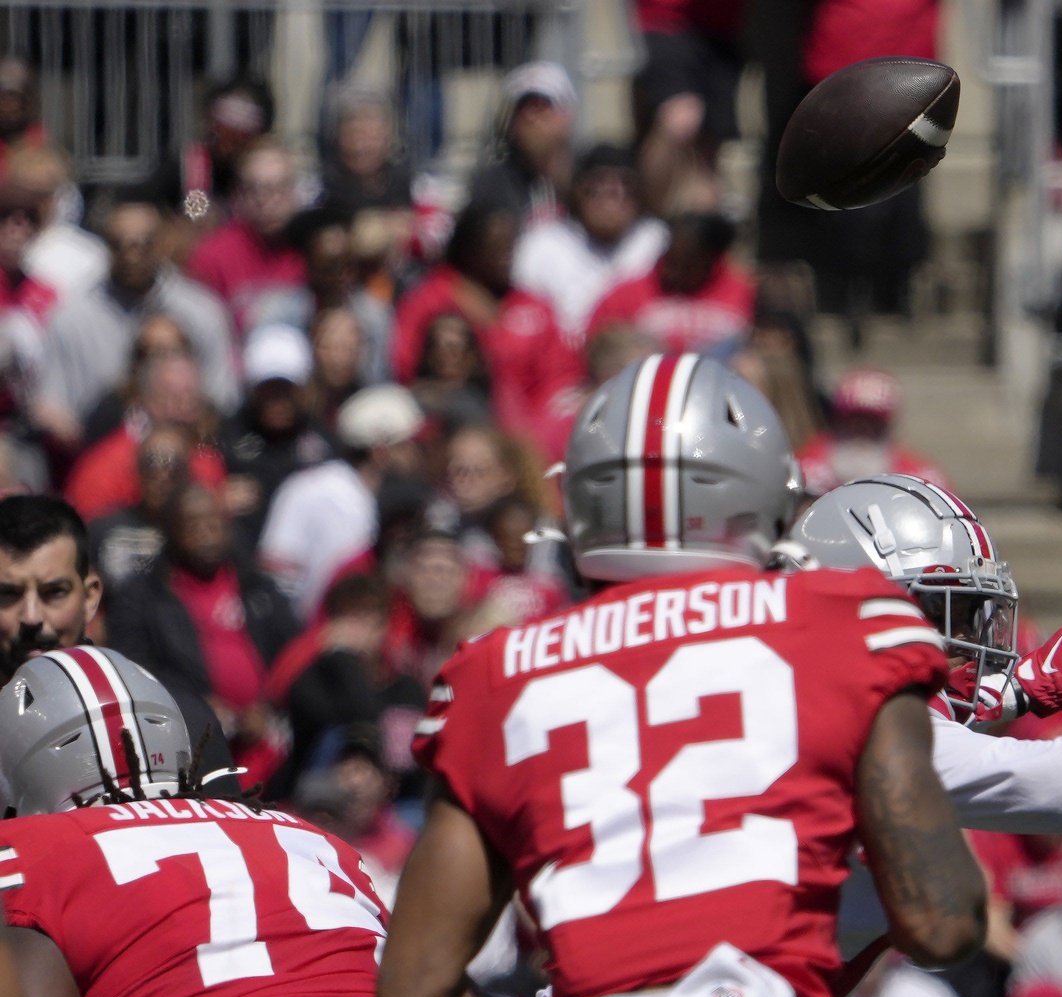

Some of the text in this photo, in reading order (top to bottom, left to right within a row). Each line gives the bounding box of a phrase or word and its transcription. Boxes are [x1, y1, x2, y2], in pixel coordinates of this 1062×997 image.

[504, 578, 787, 677] HENDERSON
[150, 753, 164, 765] 74
[503, 636, 799, 931] 32
[93, 821, 389, 987] 74
